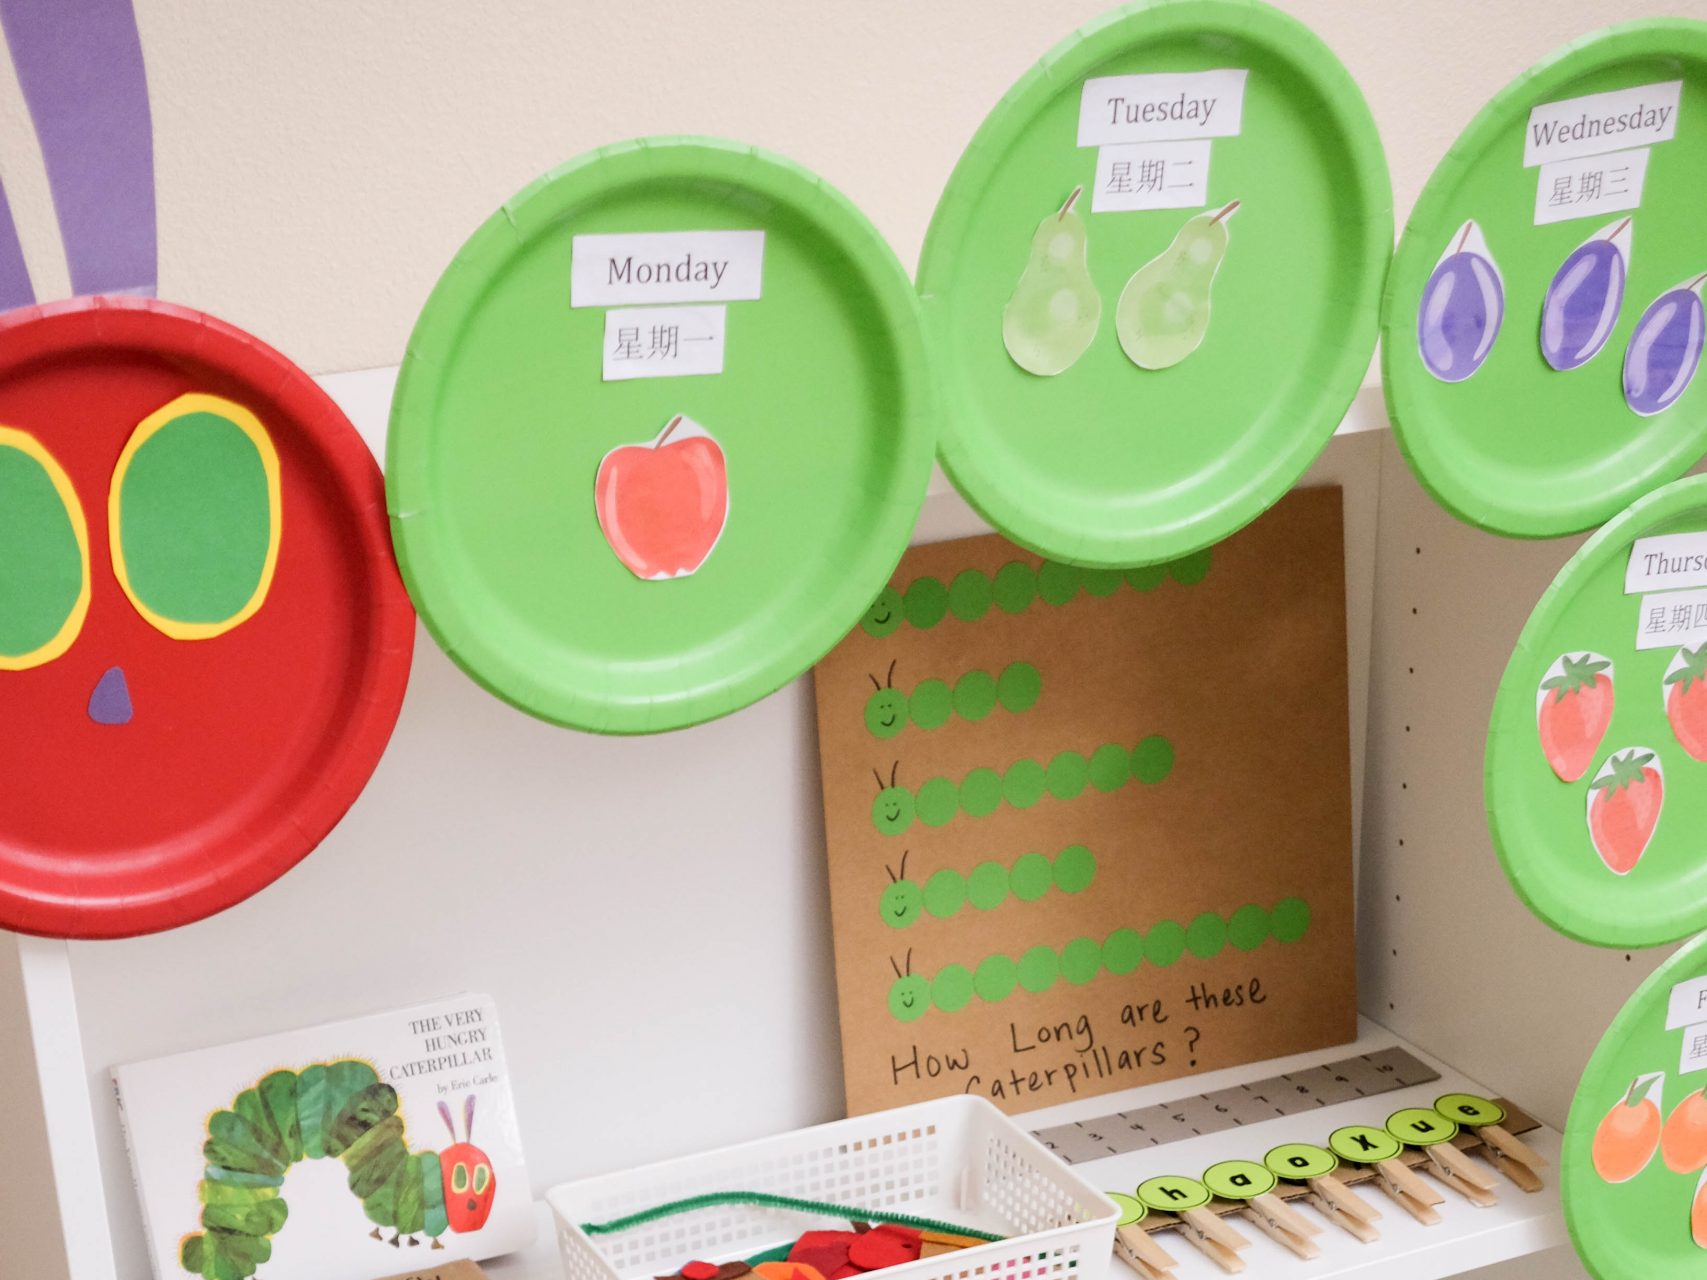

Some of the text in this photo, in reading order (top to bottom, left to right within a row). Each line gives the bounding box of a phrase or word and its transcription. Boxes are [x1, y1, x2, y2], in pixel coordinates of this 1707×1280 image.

[1107, 92, 1217, 126] Tuesday
[1532, 103, 1673, 148] Wednesday
[1105, 159, 1194, 194] 星期二
[1548, 166, 1630, 207] 星期三
[607, 253, 729, 290] Monday
[612, 324, 714, 361] 星期一
[1643, 551, 1707, 576] Thurs
[408, 1007, 484, 1035] THE VERY
[891, 977, 1267, 1086] How Long are these
[424, 1027, 488, 1053] HUNGRY
[389, 1047, 493, 1081] CATERPILLAR
[436, 1083, 448, 1095] by
[450, 1079, 471, 1090] Eric
[1045, 1064, 1394, 1150] 2 3 4 5 6 7 8 9 10
